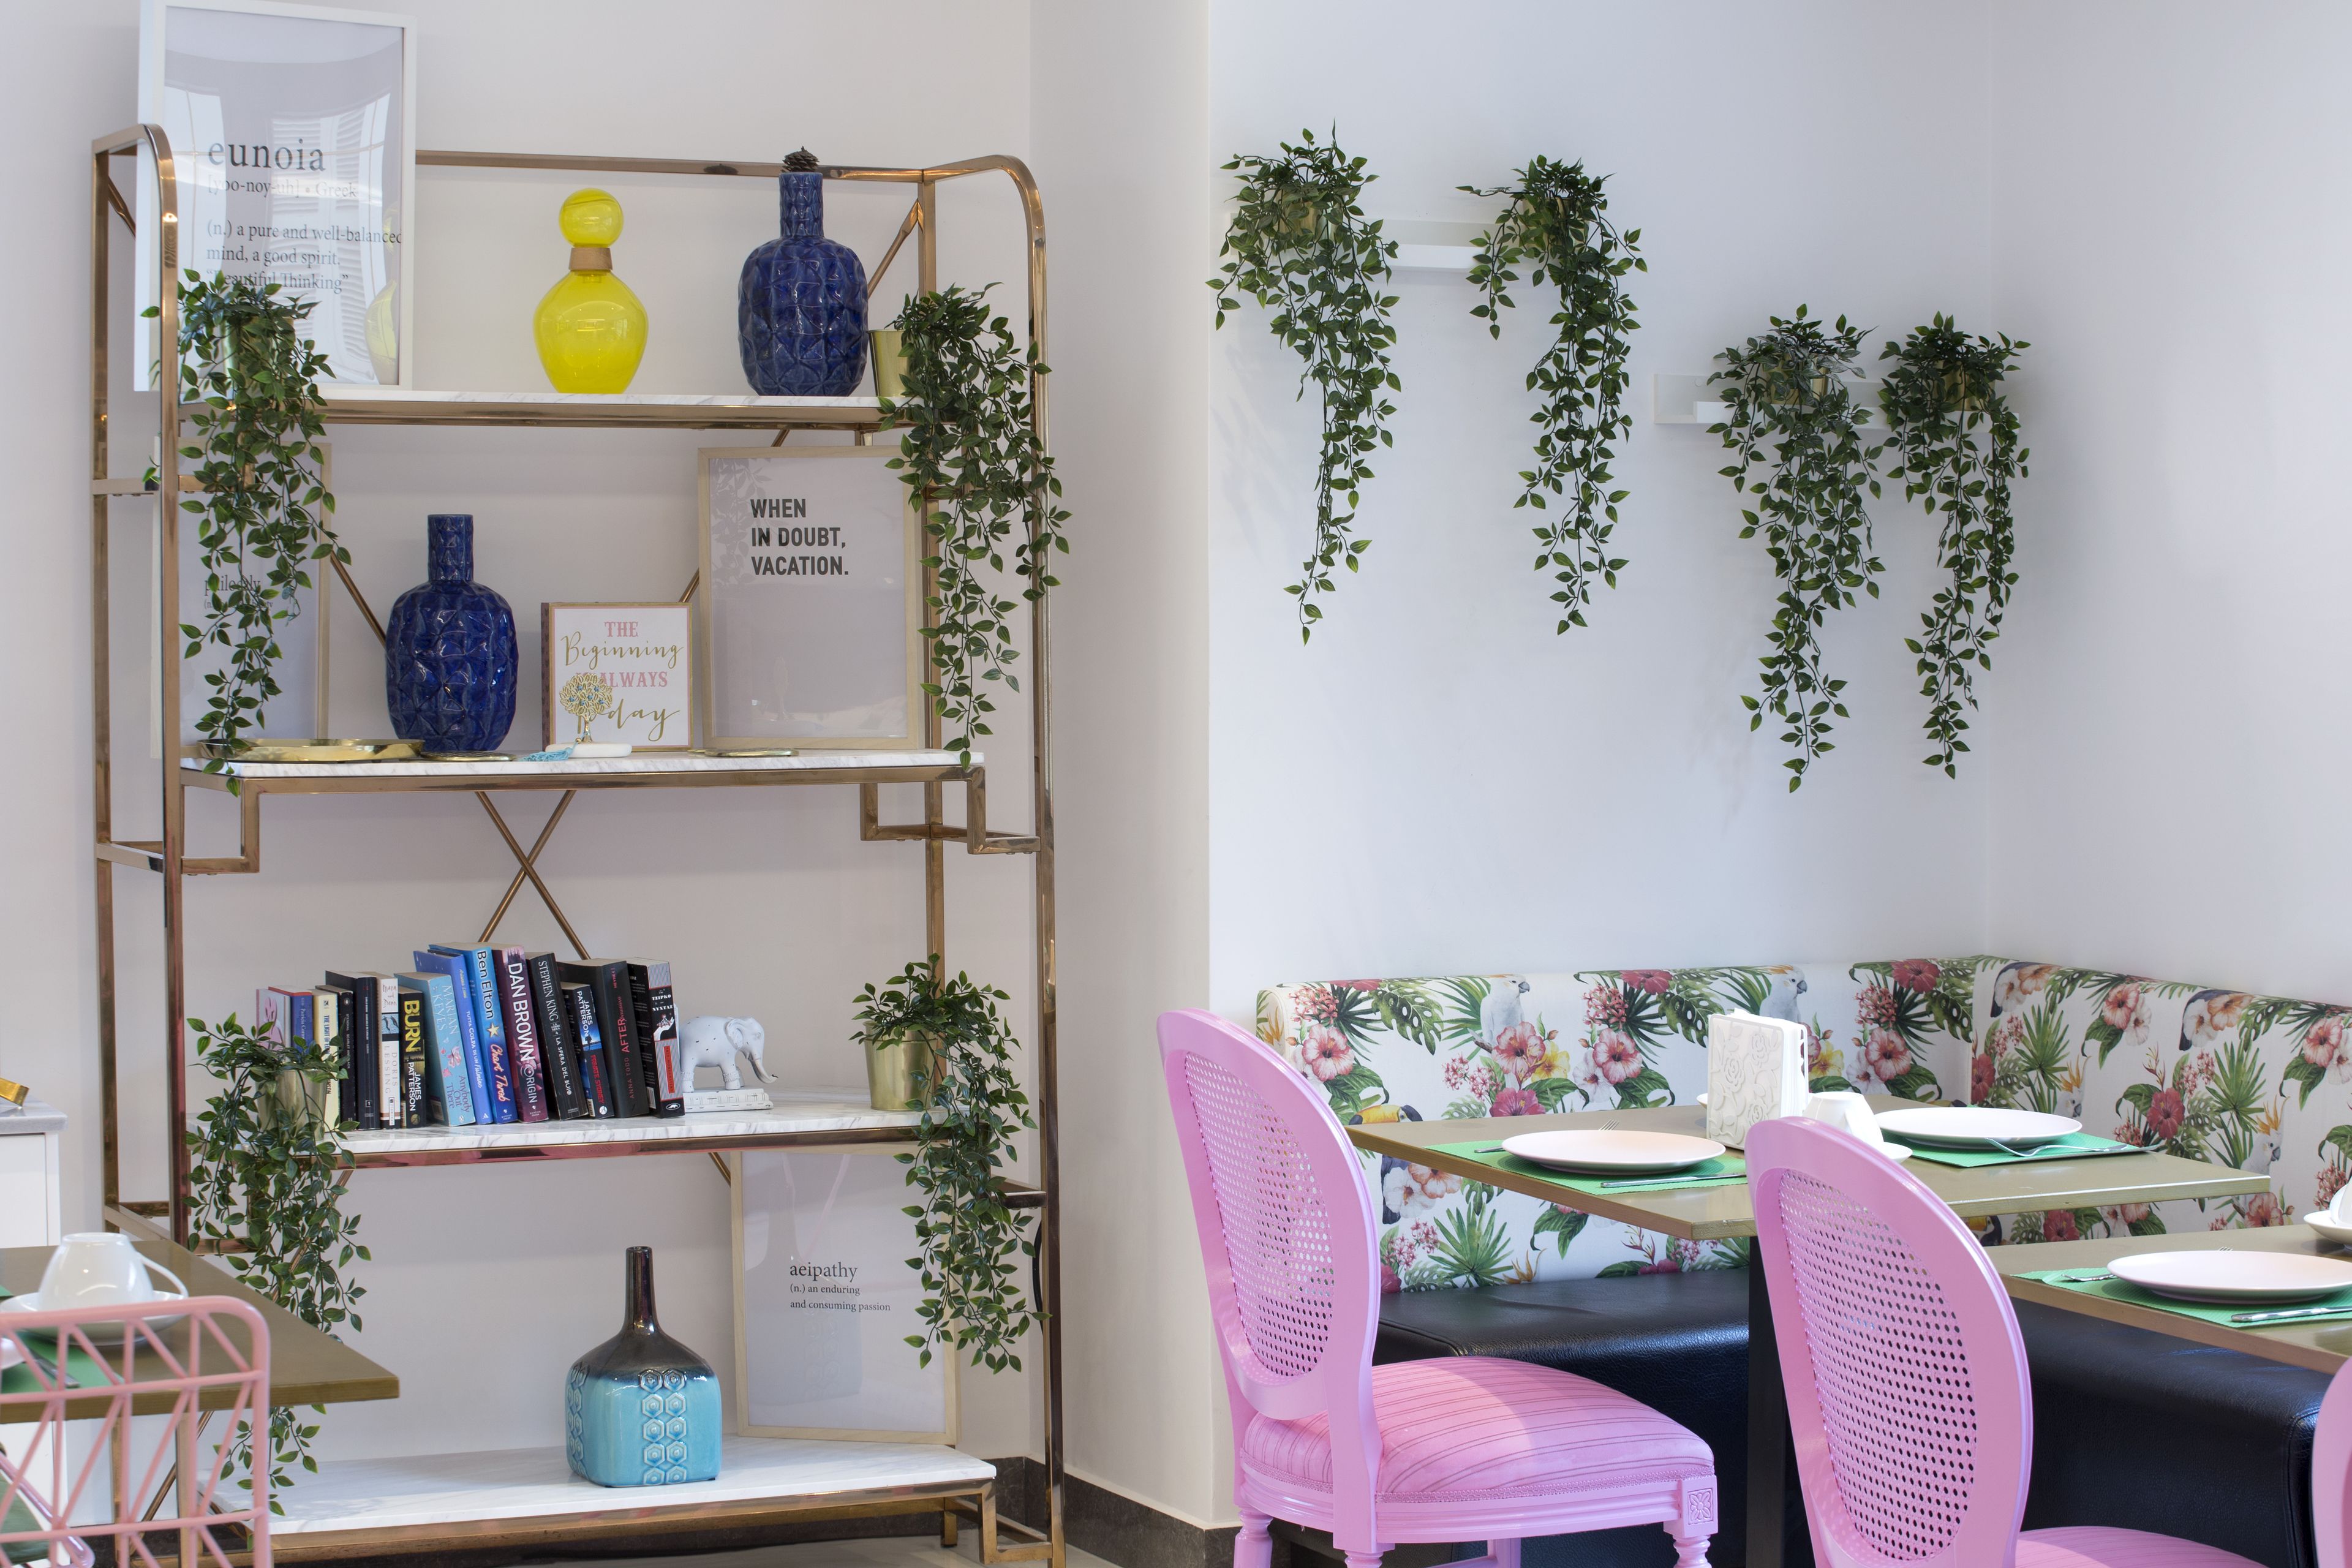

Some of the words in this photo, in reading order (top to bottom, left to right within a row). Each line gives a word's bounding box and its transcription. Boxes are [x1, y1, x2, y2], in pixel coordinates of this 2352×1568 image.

[208, 138, 326, 172] eunoia
[315, 181, 358, 197] Greek
[207, 220, 232, 238] (n.)
[237, 225, 244, 236] a
[248, 226, 280, 241] pure
[282, 224, 307, 239] and
[206, 246, 248, 263] mind,
[252, 252, 260, 262] a
[264, 247, 298, 267] good
[301, 250, 341, 269] spirit.
[281, 272, 349, 293] Thinking”
[750, 499, 806, 518] WHEN
[752, 527, 771, 547] IN
[778, 527, 846, 549] DOUBT,
[751, 556, 849, 576] VACATION.
[604, 621, 639, 638] THE
[560, 631, 684, 670] Beginning
[577, 698, 680, 742] day
[477, 949, 488, 978] Ben
[508, 962, 526, 998] DAN
[538, 960, 554, 998] STEPHEN
[546, 999, 559, 1022] KING
[432, 995, 447, 1031] KEYES
[442, 985, 459, 1035] MARIAN
[481, 981, 494, 1019] Elton
[576, 990, 590, 1036] PATTERSON
[583, 999, 593, 1025] JAMES
[404, 1000, 421, 1053] BURN
[513, 999, 535, 1061] BROWN
[617, 1018, 630, 1053] AFTER
[556, 1037, 562, 1046] LA
[489, 1044, 504, 1072] Chart
[557, 1046, 566, 1066] SFERA
[408, 1061, 417, 1112] PATTERSON
[496, 1074, 511, 1103] Throb
[522, 1063, 538, 1104] ORIGIN
[590, 1054, 600, 1077] PRIVATE
[595, 1077, 605, 1104] SYDNEY
[627, 1078, 635, 1099] ANNA
[446, 1082, 455, 1109] There
[454, 1090, 462, 1107] Out
[459, 1075, 470, 1113] Anybody
[789, 1262, 858, 1283] aeipathy
[790, 1284, 805, 1295] (n.)
[821, 1284, 861, 1297] enduring
[790, 1300, 807, 1310] and
[809, 1302, 857, 1313] consuming
[858, 1303, 891, 1313] passion
